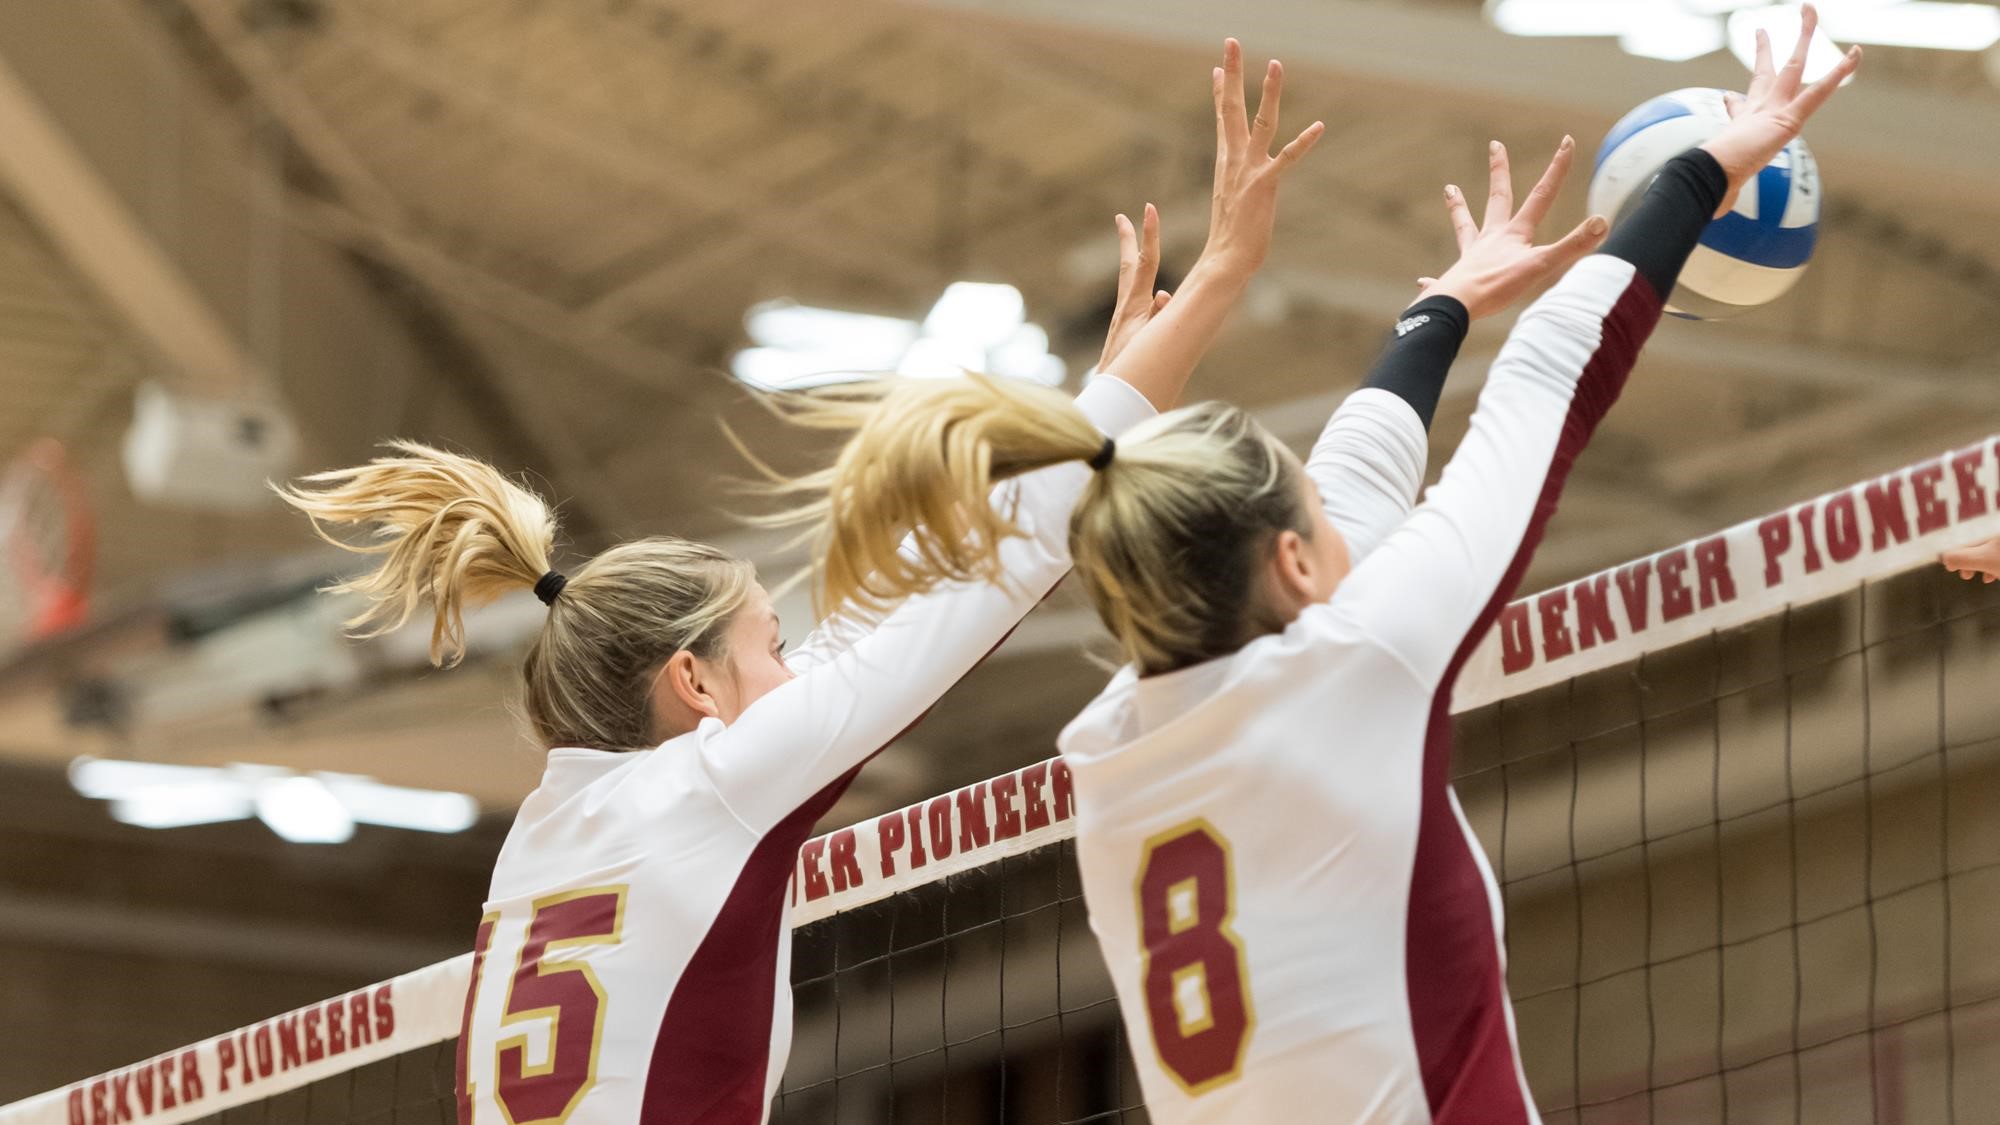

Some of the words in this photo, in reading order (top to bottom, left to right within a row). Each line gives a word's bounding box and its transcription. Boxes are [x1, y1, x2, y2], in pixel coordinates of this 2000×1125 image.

[1501, 537, 1737, 675] DENVER
[1758, 441, 2000, 588] PIONEE
[217, 984, 395, 1092] PIONEERS
[1132, 816, 1258, 1098] 8
